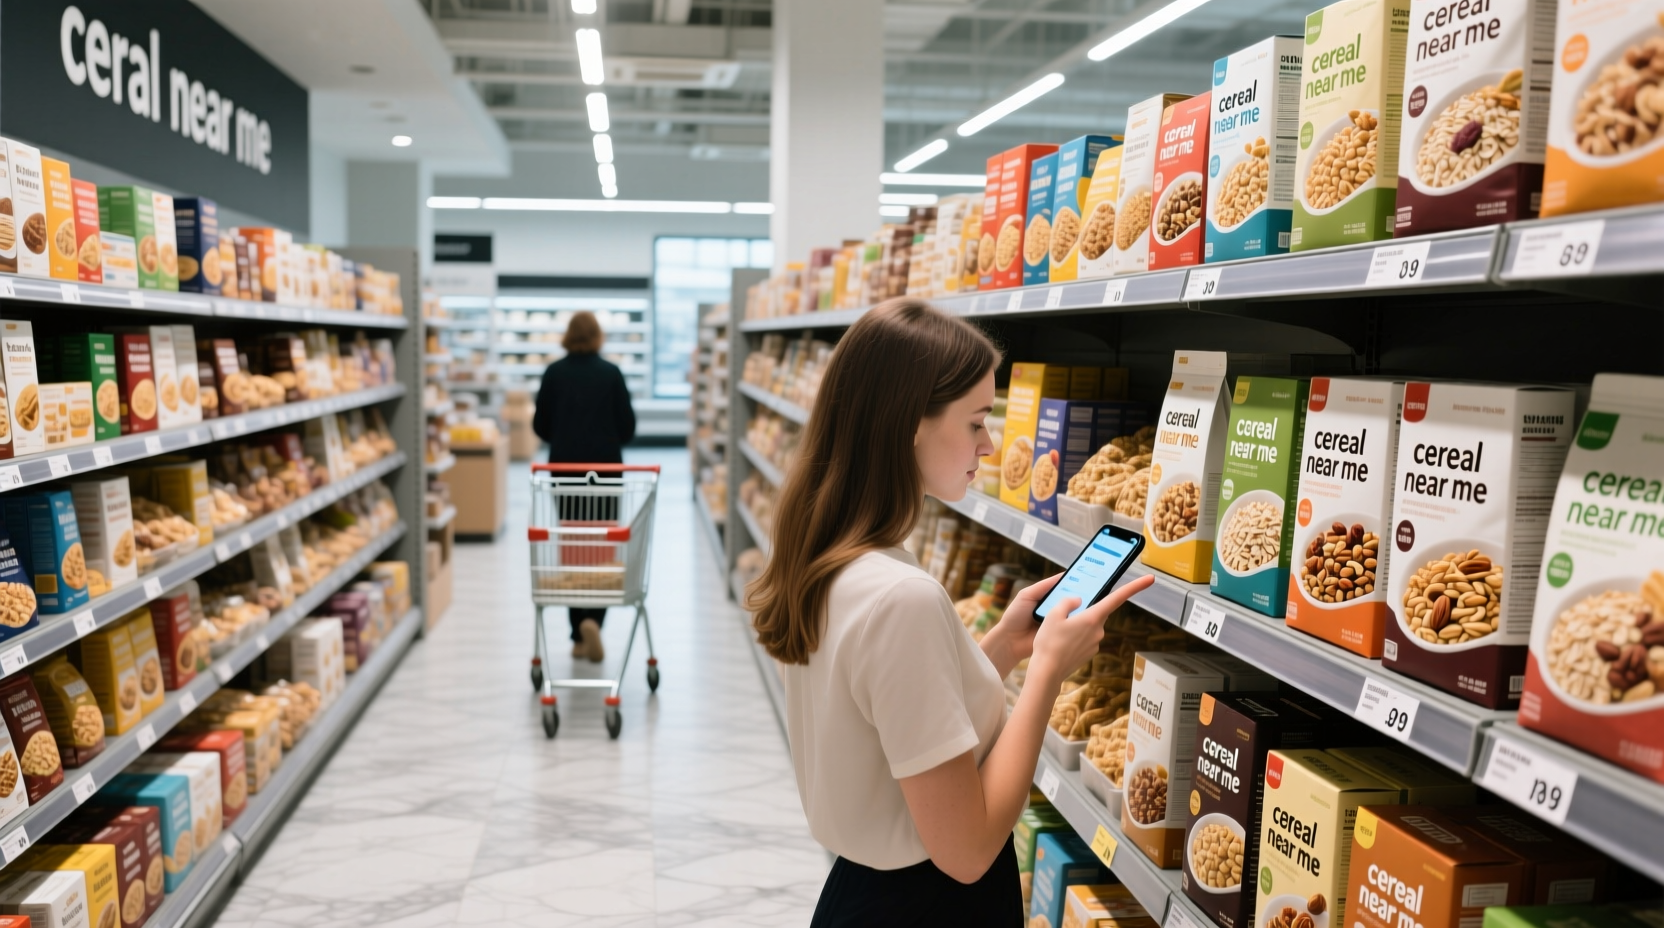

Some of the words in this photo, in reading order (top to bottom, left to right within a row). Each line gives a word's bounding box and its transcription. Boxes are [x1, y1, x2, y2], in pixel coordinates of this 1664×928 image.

[1312, 32, 1362, 74] cereal
[1416, 29, 1461, 62] near
[1465, 17, 1501, 46] me
[60, 5, 160, 123] ceral
[169, 67, 234, 156] near
[236, 107, 271, 176] me
[1218, 79, 1258, 114] cereal
[1305, 72, 1339, 100] near
[1340, 64, 1367, 89] me
[1240, 106, 1260, 127] me
[1165, 407, 1201, 430] cereal
[1181, 432, 1199, 449] me
[1256, 443, 1279, 464] me
[1314, 428, 1367, 456] cereal
[1413, 440, 1484, 473] cereal
[1306, 455, 1340, 478] near
[1340, 460, 1369, 483] me
[1404, 471, 1449, 498] near
[1451, 478, 1488, 505] me
[1583, 470, 1664, 506] cerea
[1566, 501, 1628, 532] near
[1202, 736, 1240, 771] cereal
[1220, 769, 1241, 795] me
[1273, 806, 1319, 849] cereal
[1267, 827, 1297, 860] near
[1296, 849, 1321, 878] me
[1359, 884, 1398, 925] near
[1367, 863, 1425, 916] cereal
